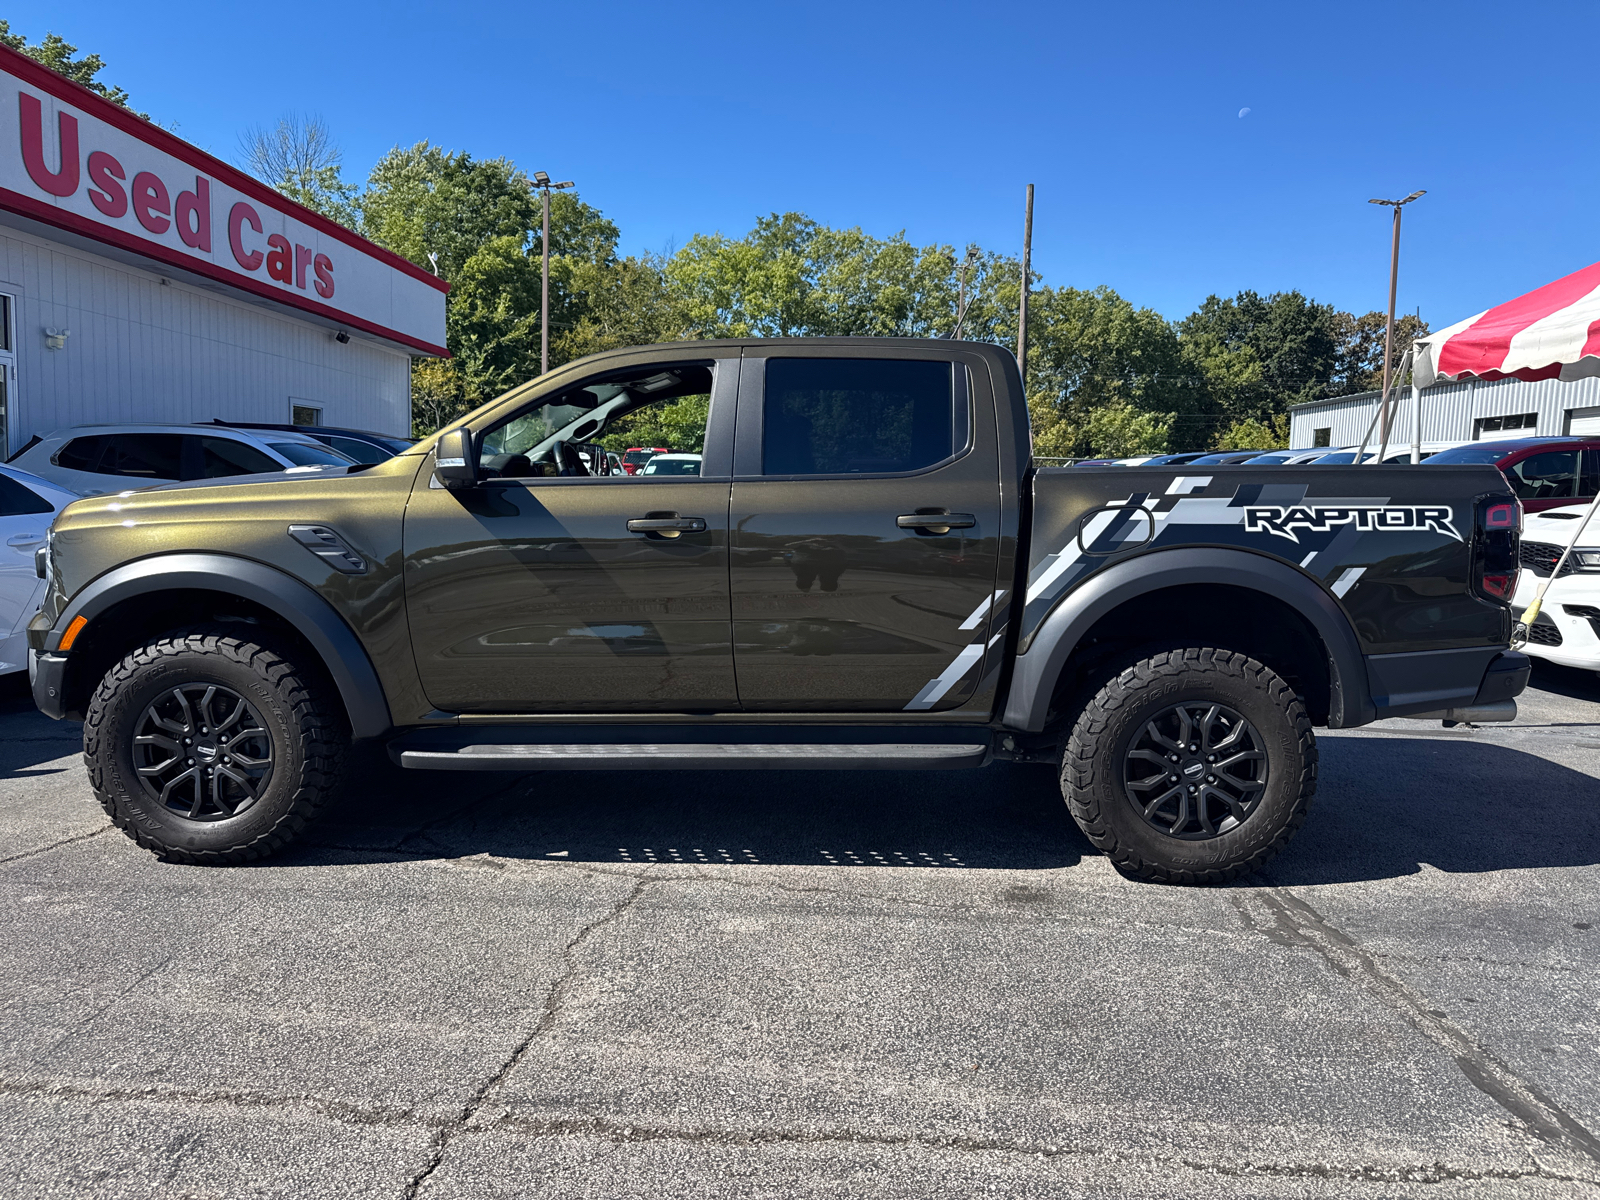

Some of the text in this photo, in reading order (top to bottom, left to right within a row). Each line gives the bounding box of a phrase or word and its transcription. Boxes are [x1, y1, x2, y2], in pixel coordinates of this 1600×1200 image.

[19, 91, 336, 299] Used Cars
[1243, 505, 1464, 544] RAPTOR
[247, 682, 296, 817] BFGoodrich
[1101, 682, 1179, 800] BFGoodrich
